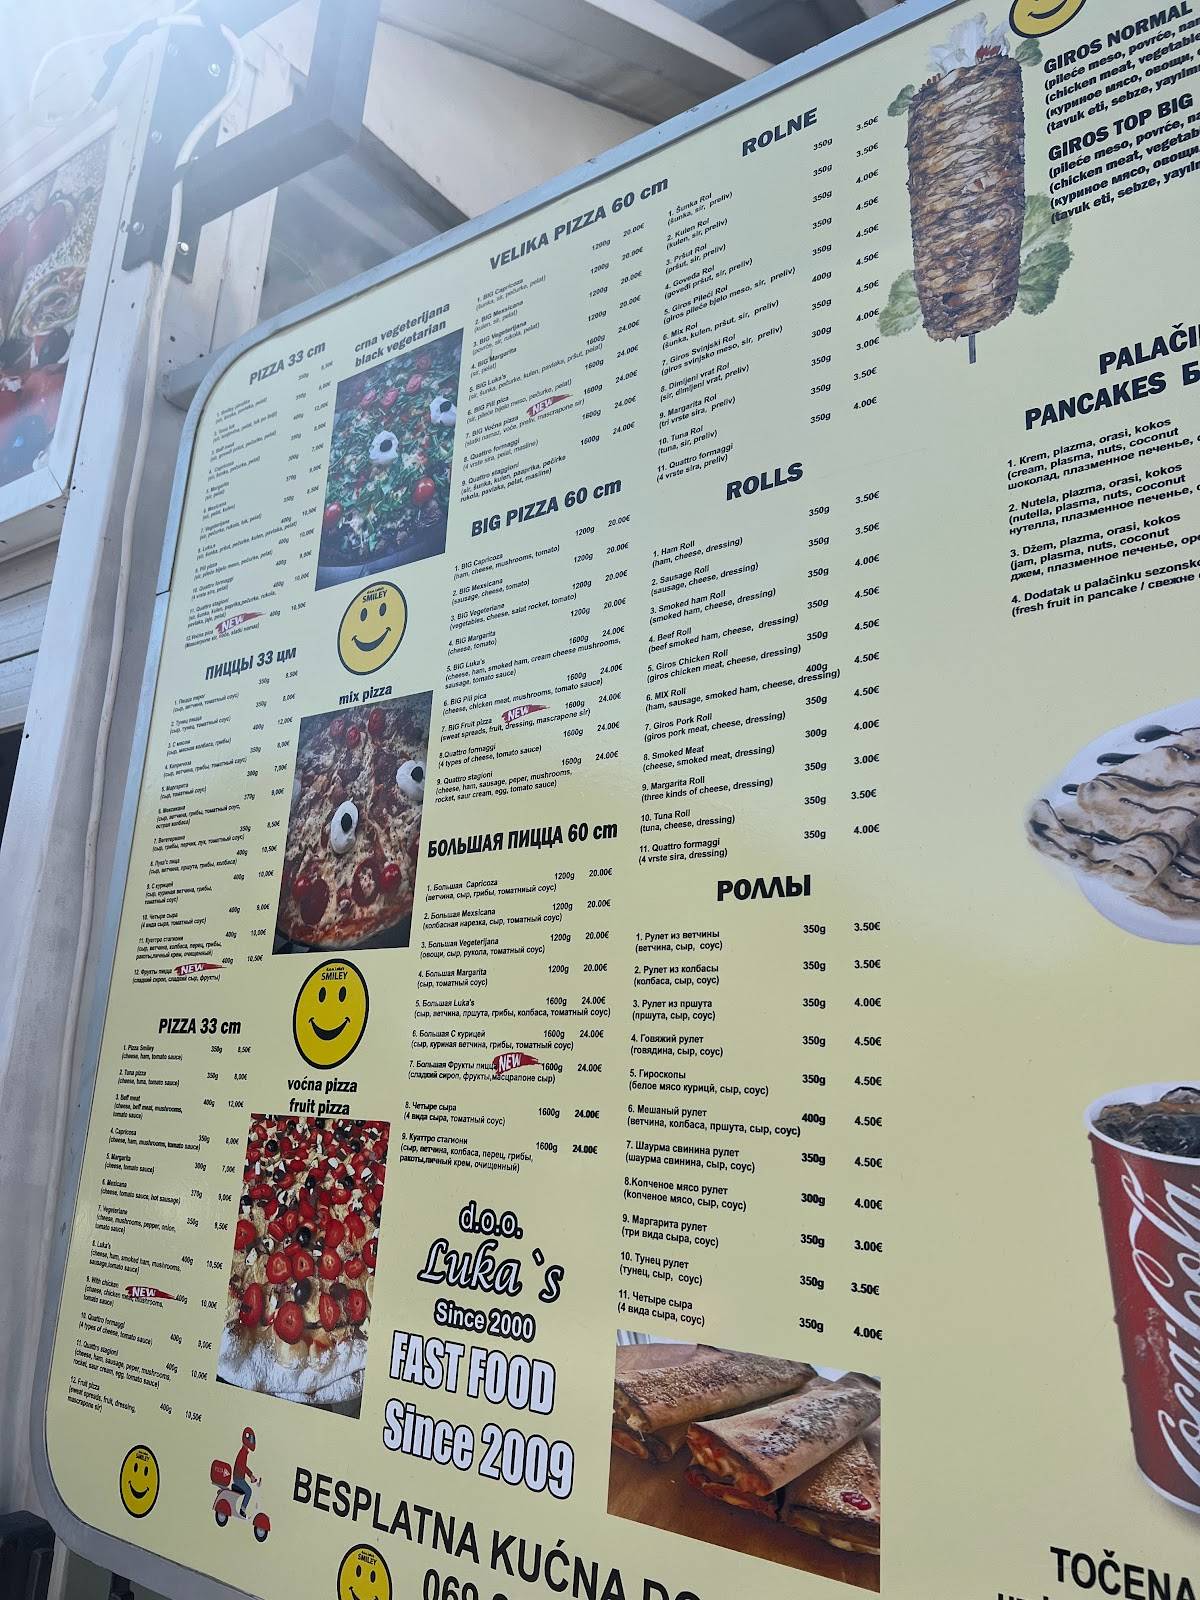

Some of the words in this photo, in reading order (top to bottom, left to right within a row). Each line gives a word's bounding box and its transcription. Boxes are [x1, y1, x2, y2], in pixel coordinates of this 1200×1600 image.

[1044, 38, 1103, 74] GIROS
[1107, 1, 1193, 47] NORMAL
[1045, 67, 1085, 90] (pileće
[1088, 51, 1125, 71] meso,
[1129, 29, 1175, 56] povrće,
[1045, 76, 1097, 104] (chicken
[1100, 60, 1135, 82] meat,
[1046, 89, 1102, 119] (куриное
[1105, 75, 1142, 94] мясо,
[1146, 53, 1194, 77] овощи,
[1047, 114, 1085, 134] (tavuk
[1088, 102, 1108, 116] eti,
[1111, 86, 1152, 105] sebze,
[1048, 126, 1109, 161] GIROS
[1113, 109, 1152, 135] TOP
[1158, 93, 1193, 119] BIG
[742, 108, 817, 157] ROLNE
[813, 138, 833, 151] 350g
[856, 116, 878, 131] 3.50€
[489, 233, 549, 270] VELIKA
[554, 206, 606, 242] PIZZA
[612, 192, 635, 213] 60
[640, 178, 668, 200] cm
[812, 271, 832, 284] 400g
[856, 252, 879, 267] 4.50€
[355, 336, 378, 353] crna
[380, 303, 451, 344] vegeterijana
[355, 348, 384, 368] black
[386, 320, 447, 358] vegetarian
[249, 360, 284, 385] PIZZA
[288, 350, 303, 367] 33
[307, 342, 325, 358] cm
[1100, 323, 1200, 375] PALAČI
[1025, 372, 1166, 430] PANCAKES
[1008, 460, 1016, 468] 1.
[1020, 450, 1050, 466] Krem,
[1053, 439, 1096, 458] plazma,
[1099, 429, 1132, 445] orasi,
[1135, 418, 1171, 434] kokos
[1008, 462, 1048, 480] (cream,
[1051, 452, 1094, 471] plasma,
[1097, 443, 1126, 457] nuts,
[1129, 428, 1179, 448] coconut
[1008, 472, 1060, 490] шоколад,
[1063, 452, 1135, 477] плазменное
[1138, 438, 1193, 458] печенье,
[726, 463, 803, 501] ROLLS
[471, 515, 501, 537] BIG
[506, 496, 559, 527] PIZZA
[564, 487, 588, 508] 60
[593, 480, 622, 499] cm
[809, 506, 829, 516] 350g
[855, 491, 879, 503] 3.50€
[652, 557, 672, 568] (ham,
[675, 549, 703, 562] cheese,
[706, 537, 743, 553] dressing)
[661, 544, 677, 556] Ham
[680, 541, 694, 551] Roll
[1011, 595, 1020, 604] 4.
[1024, 584, 1070, 602] Dodatak
[1074, 584, 1080, 592] u
[1084, 570, 1142, 590] palačinku
[1012, 602, 1044, 617] (fresh
[1047, 596, 1070, 608] fruit
[1074, 593, 1084, 603] in
[1088, 584, 1138, 602] pancake
[205, 656, 253, 680] ПИЦЦЫ
[256, 651, 273, 666] 33
[277, 648, 297, 663] цм
[339, 689, 359, 706] mix
[361, 685, 392, 704] pizza
[508, 705, 530, 721] NEW
[651, 779, 687, 791] Margarita
[689, 776, 704, 785] Roll
[428, 833, 503, 858] БОЛЬШАЯ
[508, 826, 563, 849] ПИЦЦА
[568, 823, 588, 842] 60
[593, 824, 618, 840] cm
[804, 830, 826, 840] 350g
[854, 824, 879, 834] 4.00€
[555, 872, 574, 881] 1200g
[589, 868, 612, 877] 20.00€
[717, 875, 811, 902] РОЛЛЫ
[636, 933, 642, 941] 1.
[645, 932, 668, 942] Рулет
[682, 930, 719, 939] ветчины
[803, 925, 826, 934] 350g
[854, 922, 880, 932] 3.50€
[635, 944, 673, 953] (ветчина,
[676, 942, 695, 952] сыр,
[700, 941, 723, 951] соус)
[180, 963, 205, 975] NEW
[321, 972, 348, 980] SMILEY
[158, 1018, 196, 1034] PIZZA
[200, 1018, 217, 1034] 33
[221, 1021, 241, 1034] cm
[631, 1035, 638, 1043] 4.
[641, 1034, 676, 1043] Говяжий
[679, 1035, 703, 1045] рулет
[803, 1036, 826, 1047] 350g
[855, 1037, 881, 1046] 4.50€
[499, 1053, 521, 1071] NEW
[288, 1076, 322, 1091] voćna
[325, 1078, 357, 1094] pizza
[289, 1098, 315, 1113] fruit
[318, 1101, 350, 1116] pizza
[459, 1201, 523, 1238] d.o.o.
[132, 1287, 157, 1298] NEW
[618, 1290, 630, 1299] 11.
[633, 1292, 666, 1306] Четыре
[668, 1299, 692, 1310] сыра
[434, 1299, 487, 1332] Since
[489, 1309, 535, 1341] 2000
[799, 1318, 824, 1332] 350g
[854, 1327, 882, 1340] 4.00€
[389, 1330, 464, 1392] FAST
[467, 1346, 555, 1415] FOOD
[383, 1398, 474, 1470] Since
[478, 1423, 574, 1499] 2009
[293, 1467, 479, 1564] BESPLATNA
[490, 1530, 626, 1600] KUĆNA
[1050, 1546, 1196, 1600] TOČENA
